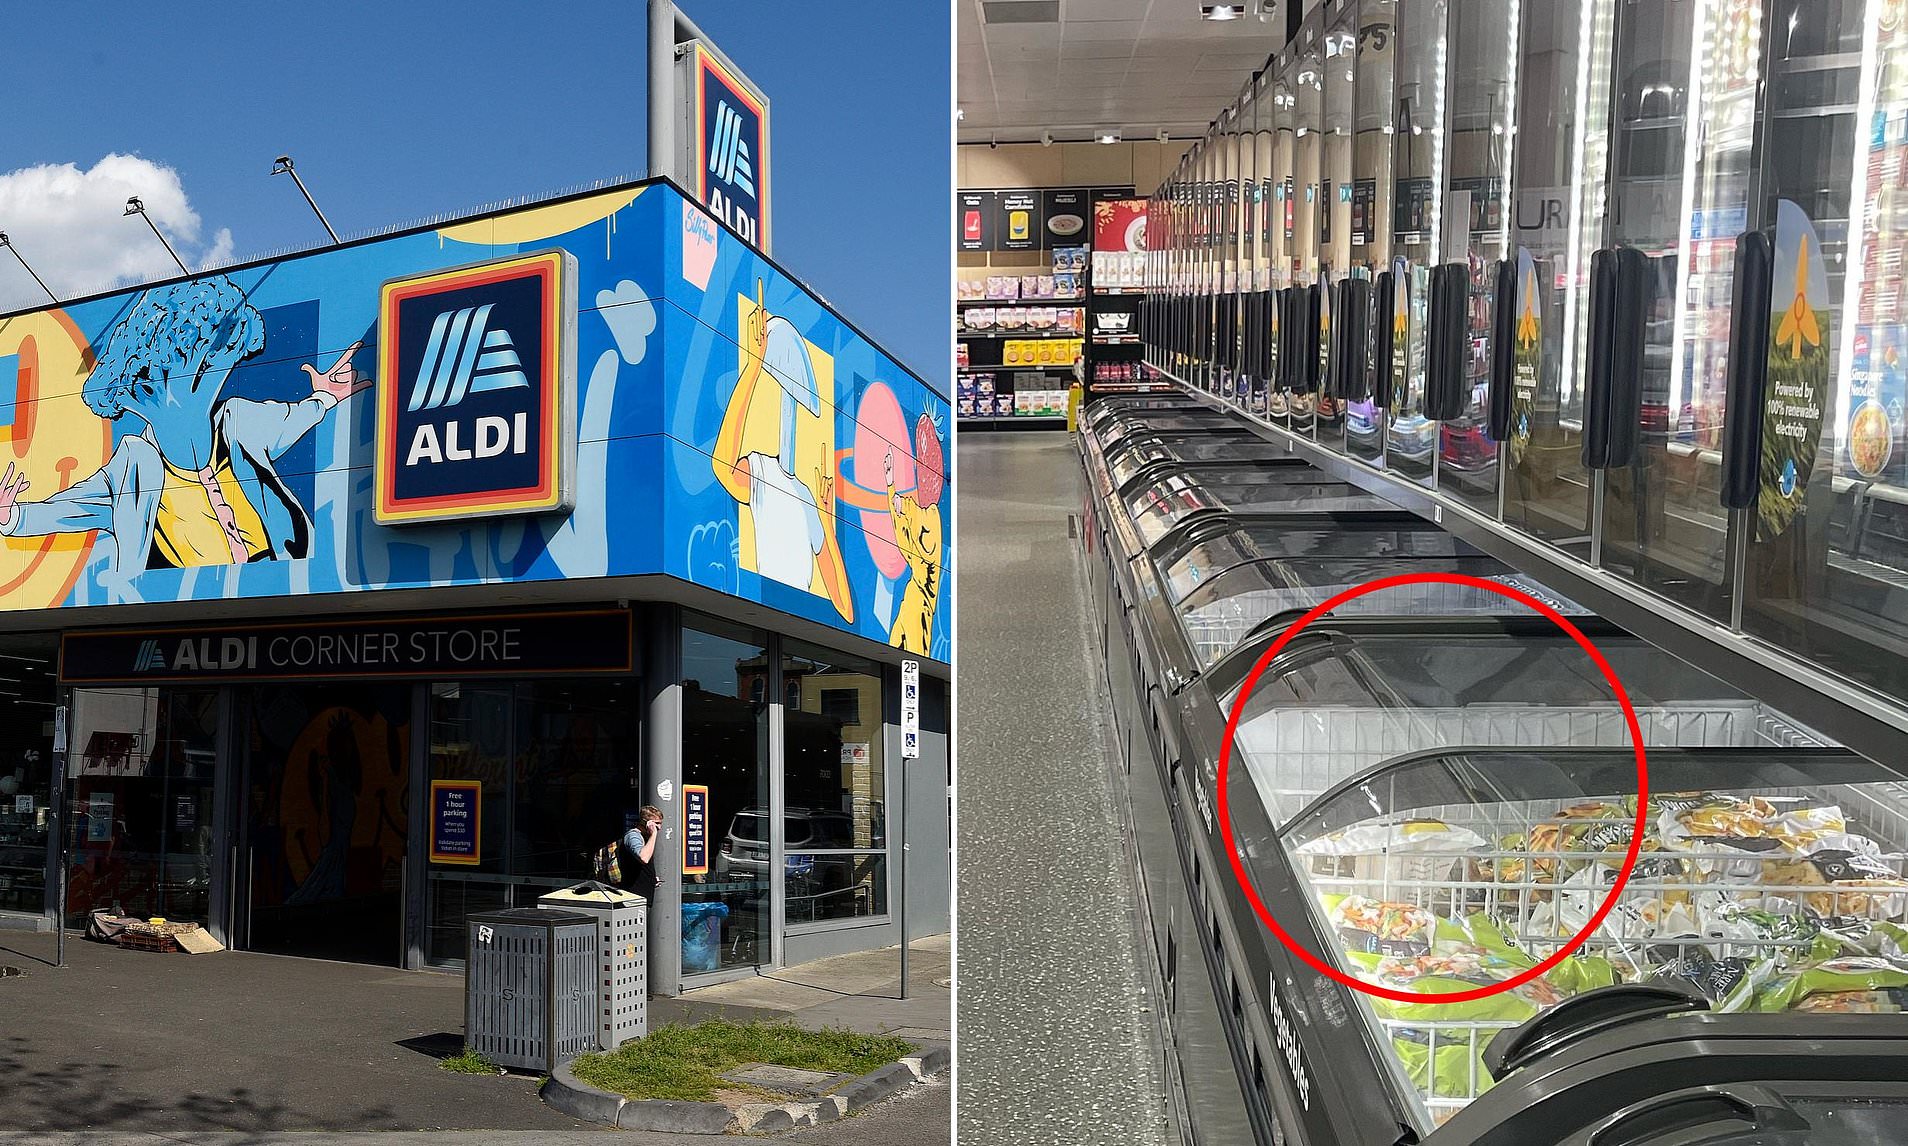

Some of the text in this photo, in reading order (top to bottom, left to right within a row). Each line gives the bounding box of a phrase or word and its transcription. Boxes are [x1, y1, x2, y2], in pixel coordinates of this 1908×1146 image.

[709, 187, 756, 247] ALDI
[1775, 381, 1814, 403] Powered by
[1767, 401, 1820, 420] 100% renewable
[406, 412, 528, 466] ALDI
[1775, 420, 1808, 443] electricity
[173, 628, 521, 671] ALDI CORNER STORE
[904, 661, 917, 673] 2P
[907, 712, 914, 723] P
[443, 809, 467, 818] parking
[1269, 971, 1310, 1112] Vegetables
